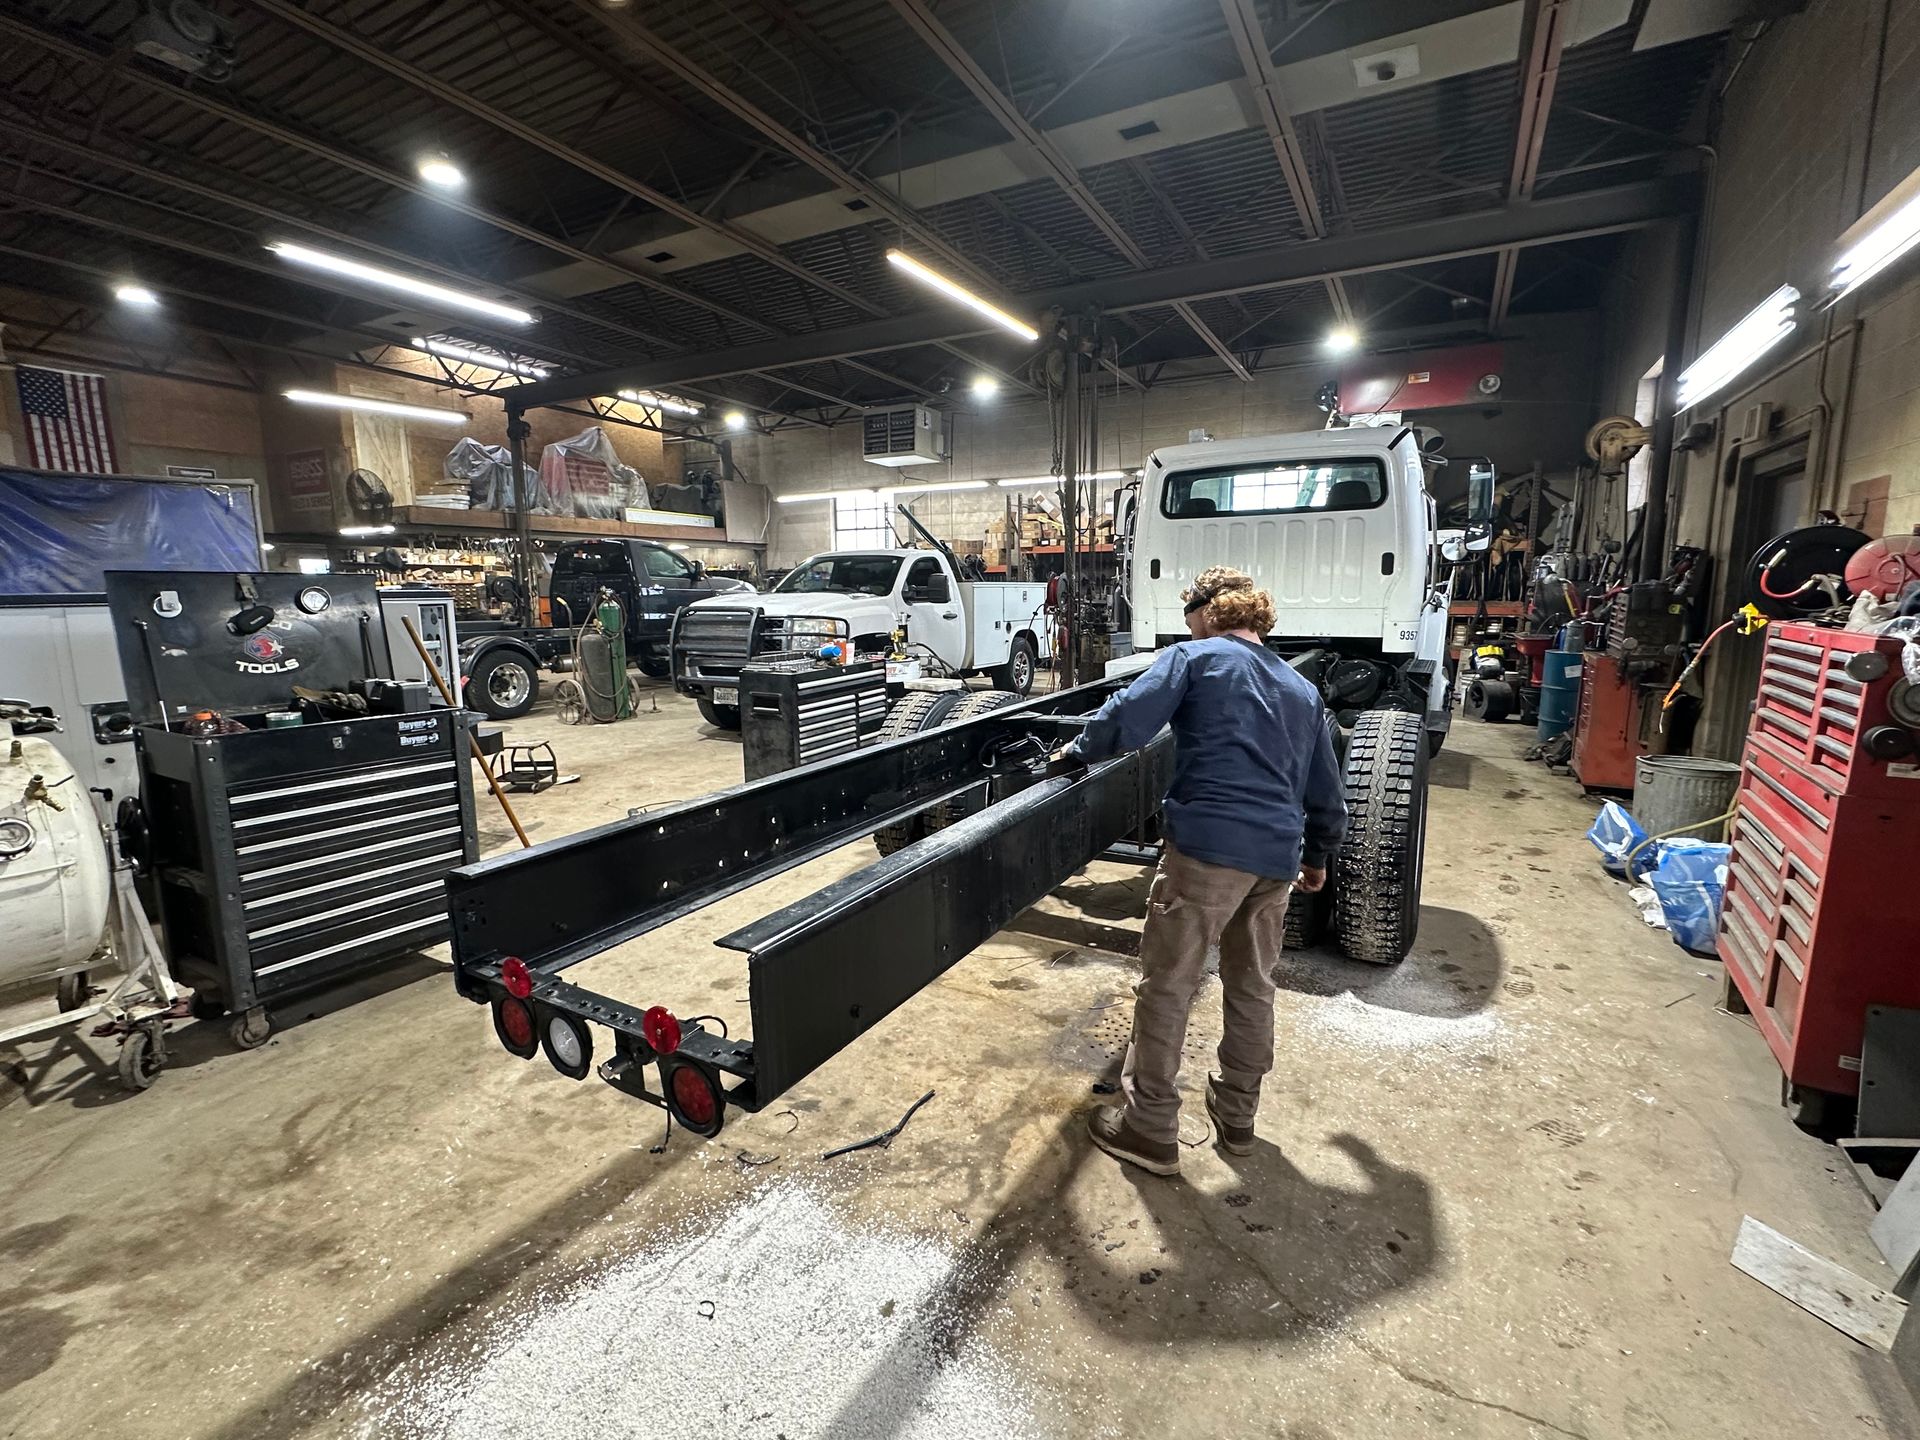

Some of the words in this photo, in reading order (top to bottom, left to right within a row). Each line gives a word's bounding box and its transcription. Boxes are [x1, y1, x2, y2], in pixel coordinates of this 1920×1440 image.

[1399, 630, 1418, 640] 9357
[235, 658, 300, 674] TOOLS
[398, 720, 426, 730] Buyers
[400, 735, 428, 746] Buyers
